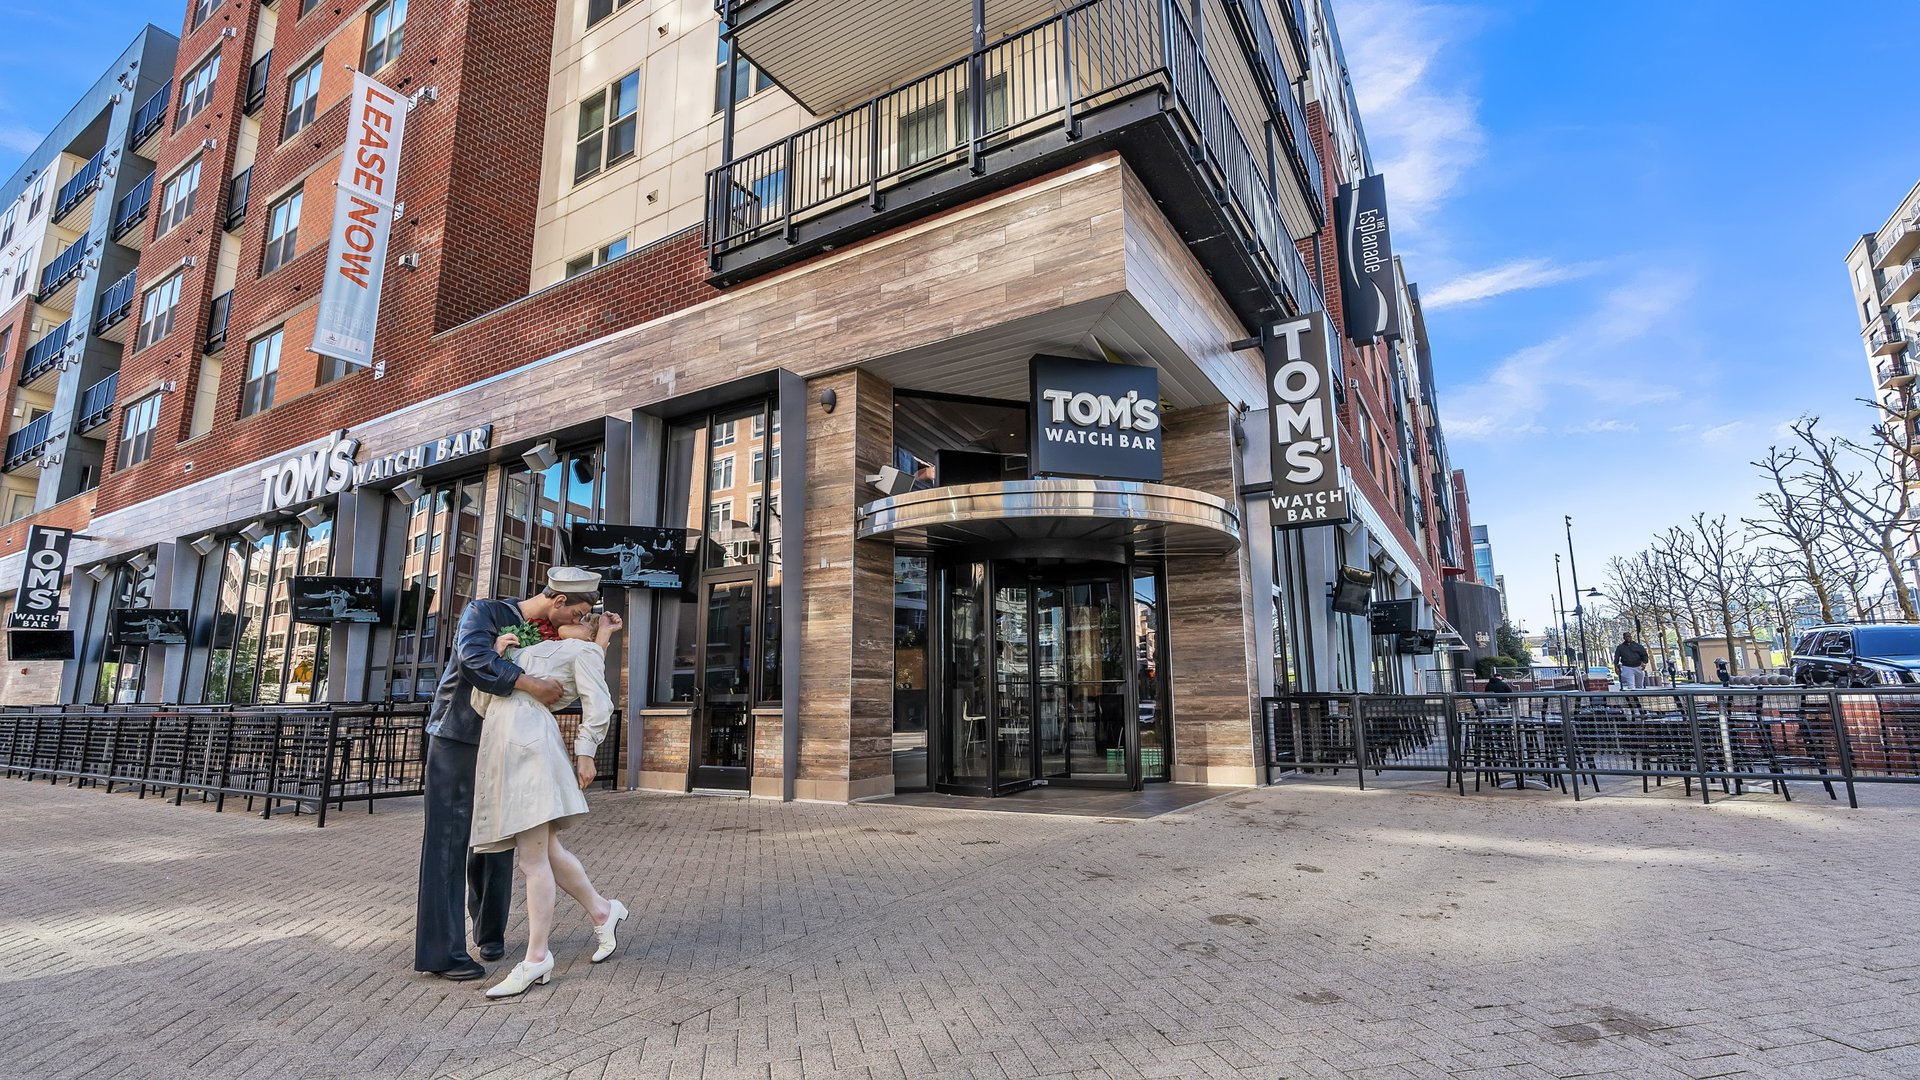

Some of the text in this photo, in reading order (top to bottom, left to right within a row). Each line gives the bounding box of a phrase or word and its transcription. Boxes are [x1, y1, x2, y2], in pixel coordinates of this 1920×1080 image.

[340, 86, 394, 289] LEASE NOW
[1376, 216, 1386, 230] THE
[1355, 208, 1389, 273] Esplanade
[1043, 389, 1159, 432] TOM'S
[1044, 427, 1156, 450] WATCH BAR
[260, 427, 489, 512] TOM'S WATCH BAR
[1272, 489, 1343, 510] WATCH
[1287, 506, 1328, 522] BAR
[14, 613, 60, 622] WATCH
[22, 620, 48, 628] BAR
